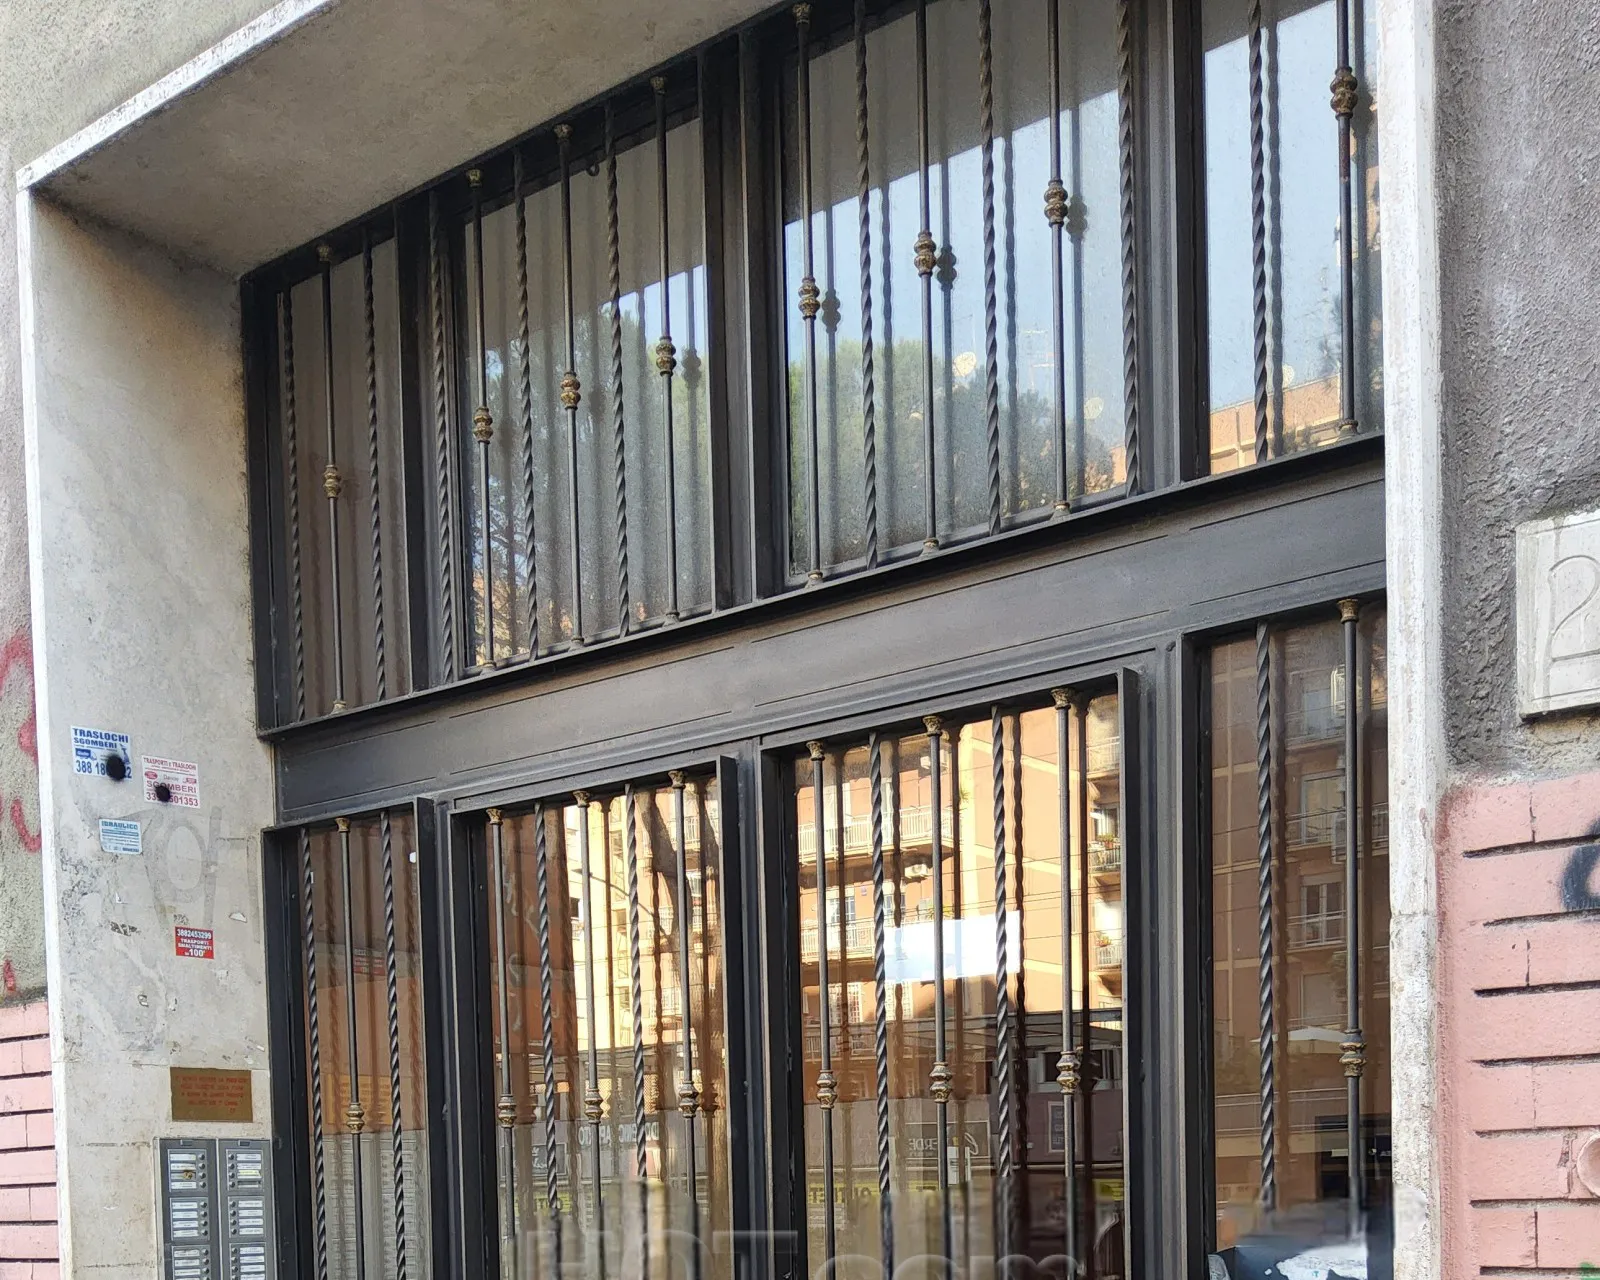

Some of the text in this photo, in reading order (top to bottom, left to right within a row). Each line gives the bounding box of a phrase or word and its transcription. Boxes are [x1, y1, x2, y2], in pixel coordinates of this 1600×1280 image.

[72, 727, 129, 743] TRASLOCHI
[73, 737, 117, 749] SGOMBERI
[75, 759, 92, 774] 388
[143, 757, 168, 767] TRASPORTI
[172, 762, 196, 771] TRASLOCHI
